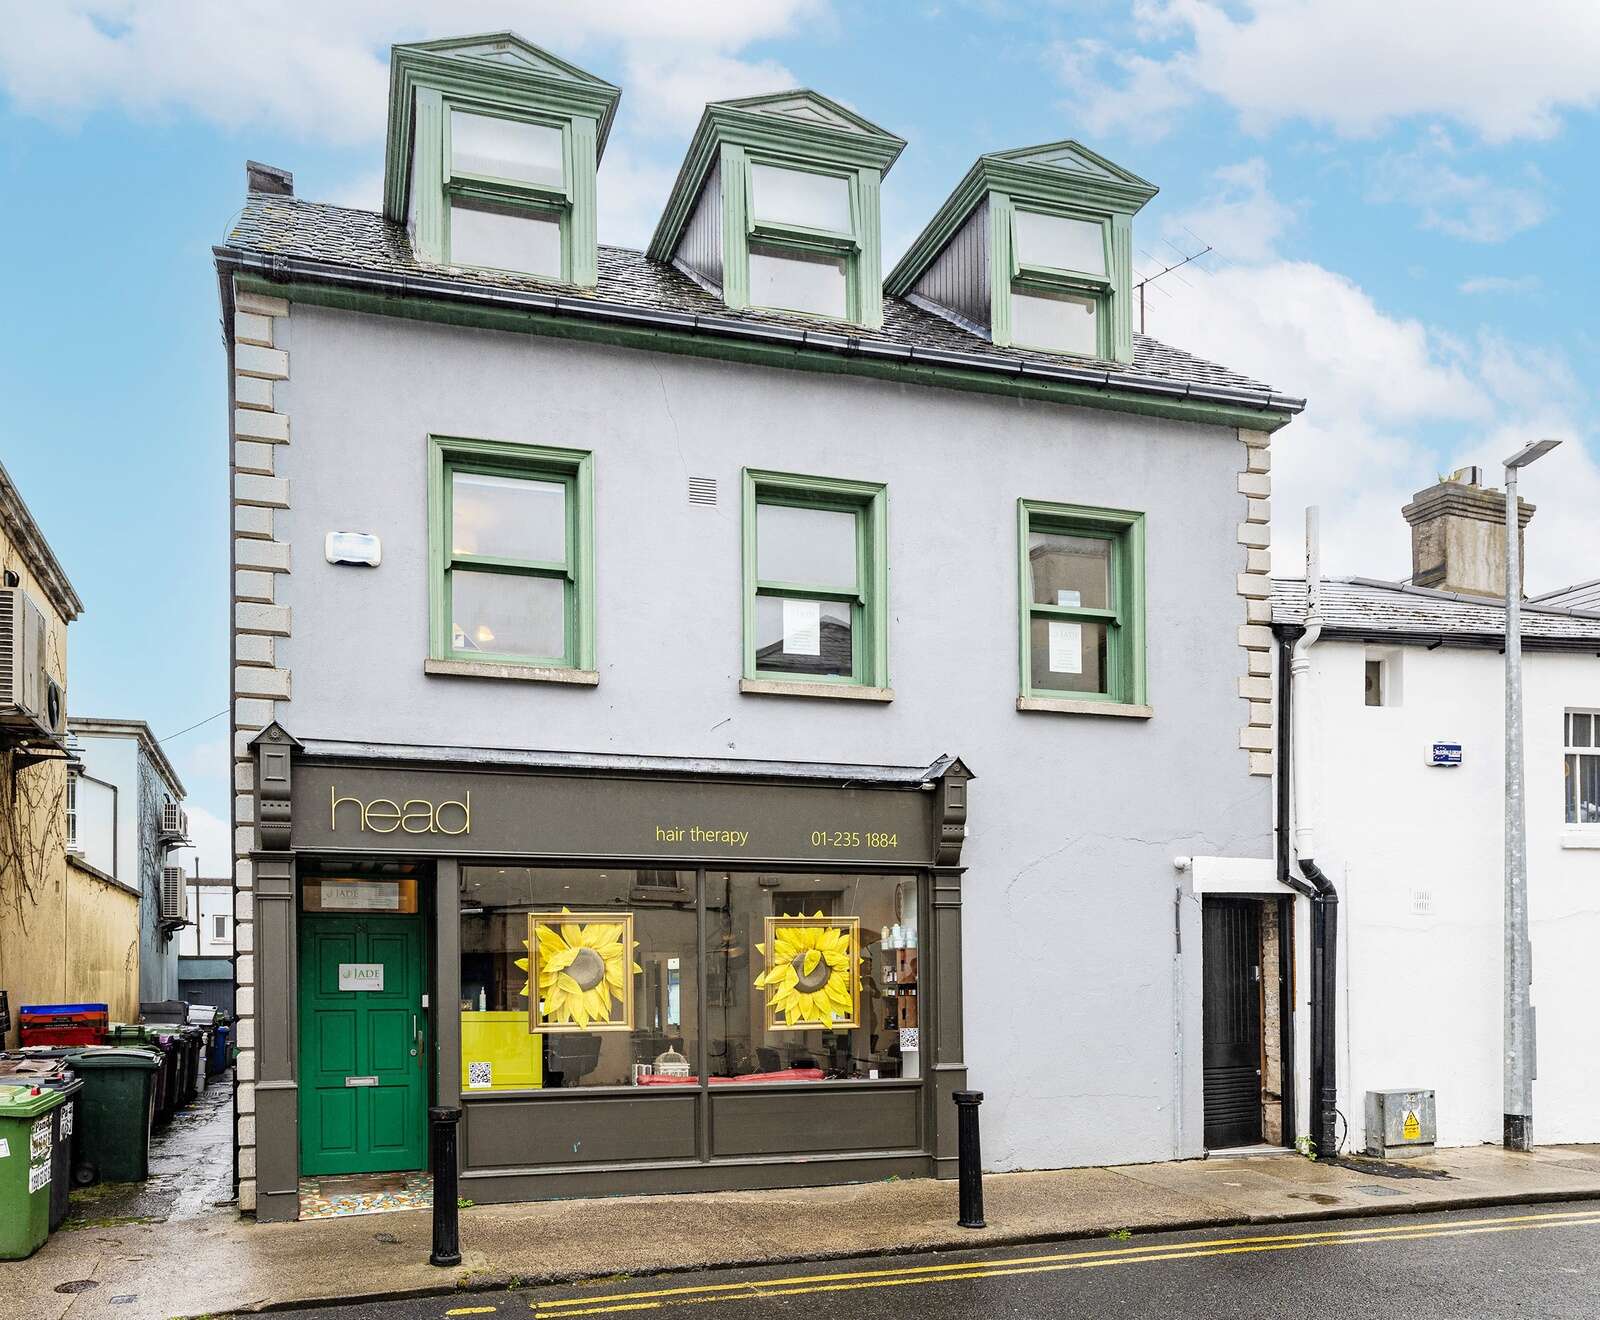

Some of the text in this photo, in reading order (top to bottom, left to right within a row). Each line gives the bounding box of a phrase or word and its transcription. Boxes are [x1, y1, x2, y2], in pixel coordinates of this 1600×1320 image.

[331, 785, 470, 835] head
[655, 825, 749, 847] hair therapy
[811, 831, 898, 848] 01-235 1884
